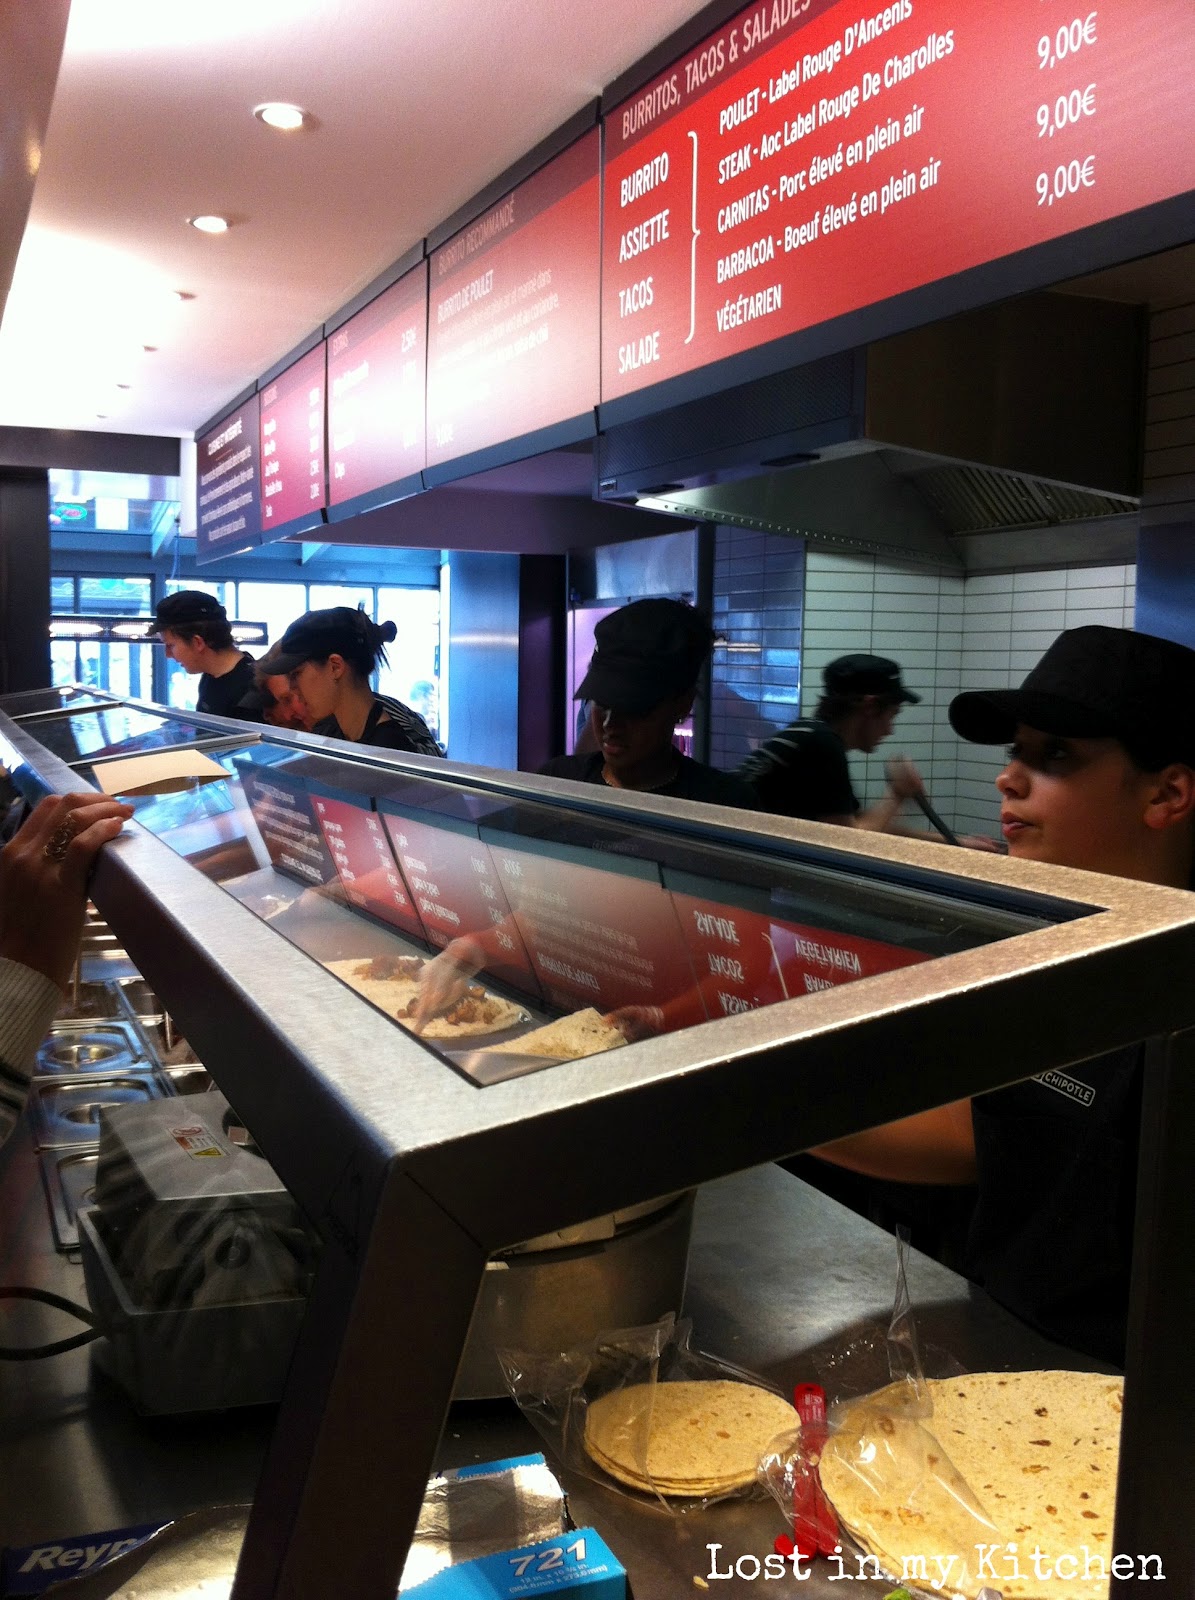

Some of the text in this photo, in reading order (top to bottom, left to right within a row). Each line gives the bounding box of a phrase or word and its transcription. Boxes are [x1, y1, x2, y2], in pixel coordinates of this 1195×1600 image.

[1037, 11, 1098, 70] 9,00€
[622, 74, 681, 140] BURRITOS,
[685, 39, 724, 94] TACOS
[729, 29, 738, 63] &
[718, 142, 751, 185] STEAK
[760, 131, 782, 160] Aoc
[784, 104, 816, 147] Label
[818, 85, 859, 127] Rouge
[862, 72, 880, 102] De
[884, 29, 954, 88] Charolles
[719, 88, 760, 135] POULET
[769, 61, 800, 104] Label
[802, 40, 841, 83] Rouge
[1036, 83, 1097, 138] 9,00€
[620, 151, 670, 208] BURRITO
[718, 184, 769, 234] CARNITAS
[779, 170, 806, 202] Porc
[808, 142, 842, 186] élevé
[846, 140, 863, 167] en
[866, 118, 900, 163] plein
[903, 104, 924, 137] air
[1035, 155, 1096, 206] 9,00€
[618, 209, 670, 264] ASSIETTE
[717, 235, 774, 284] BARBACOA
[784, 211, 820, 253] Boeuf
[822, 192, 857, 235] élevé
[860, 190, 877, 217] en
[881, 170, 916, 214] plein
[920, 157, 941, 191] air
[618, 277, 654, 319] TACOS
[716, 284, 782, 333] VÉGÉTARIEN
[617, 331, 661, 375] SALADE
[1045, 1072, 1092, 1101] CHIPOTLE
[509, 1538, 587, 1577] 721
